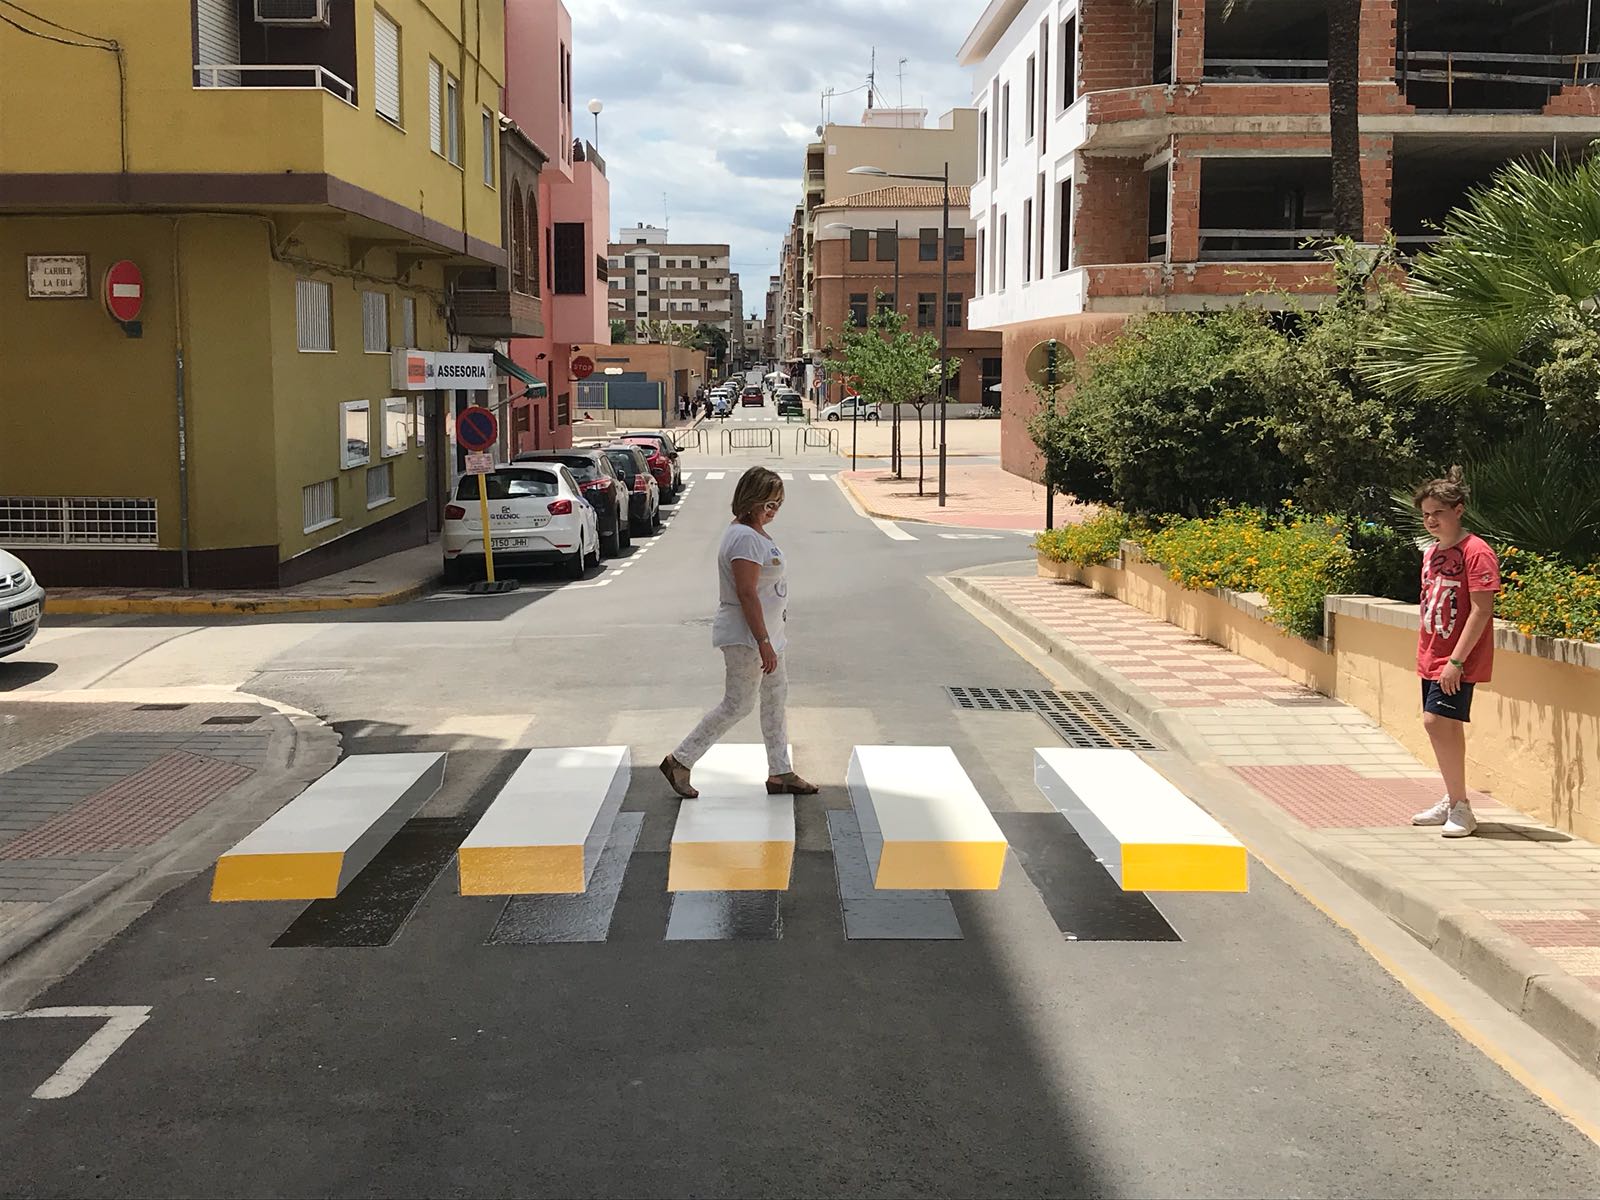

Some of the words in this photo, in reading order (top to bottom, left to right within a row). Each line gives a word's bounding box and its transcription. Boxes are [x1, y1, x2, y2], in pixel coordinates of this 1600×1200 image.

[44, 267, 72, 275] CARRER
[43, 279, 53, 287] LA
[437, 365, 486, 378] ASSESORIA
[512, 538, 527, 546] JHH
